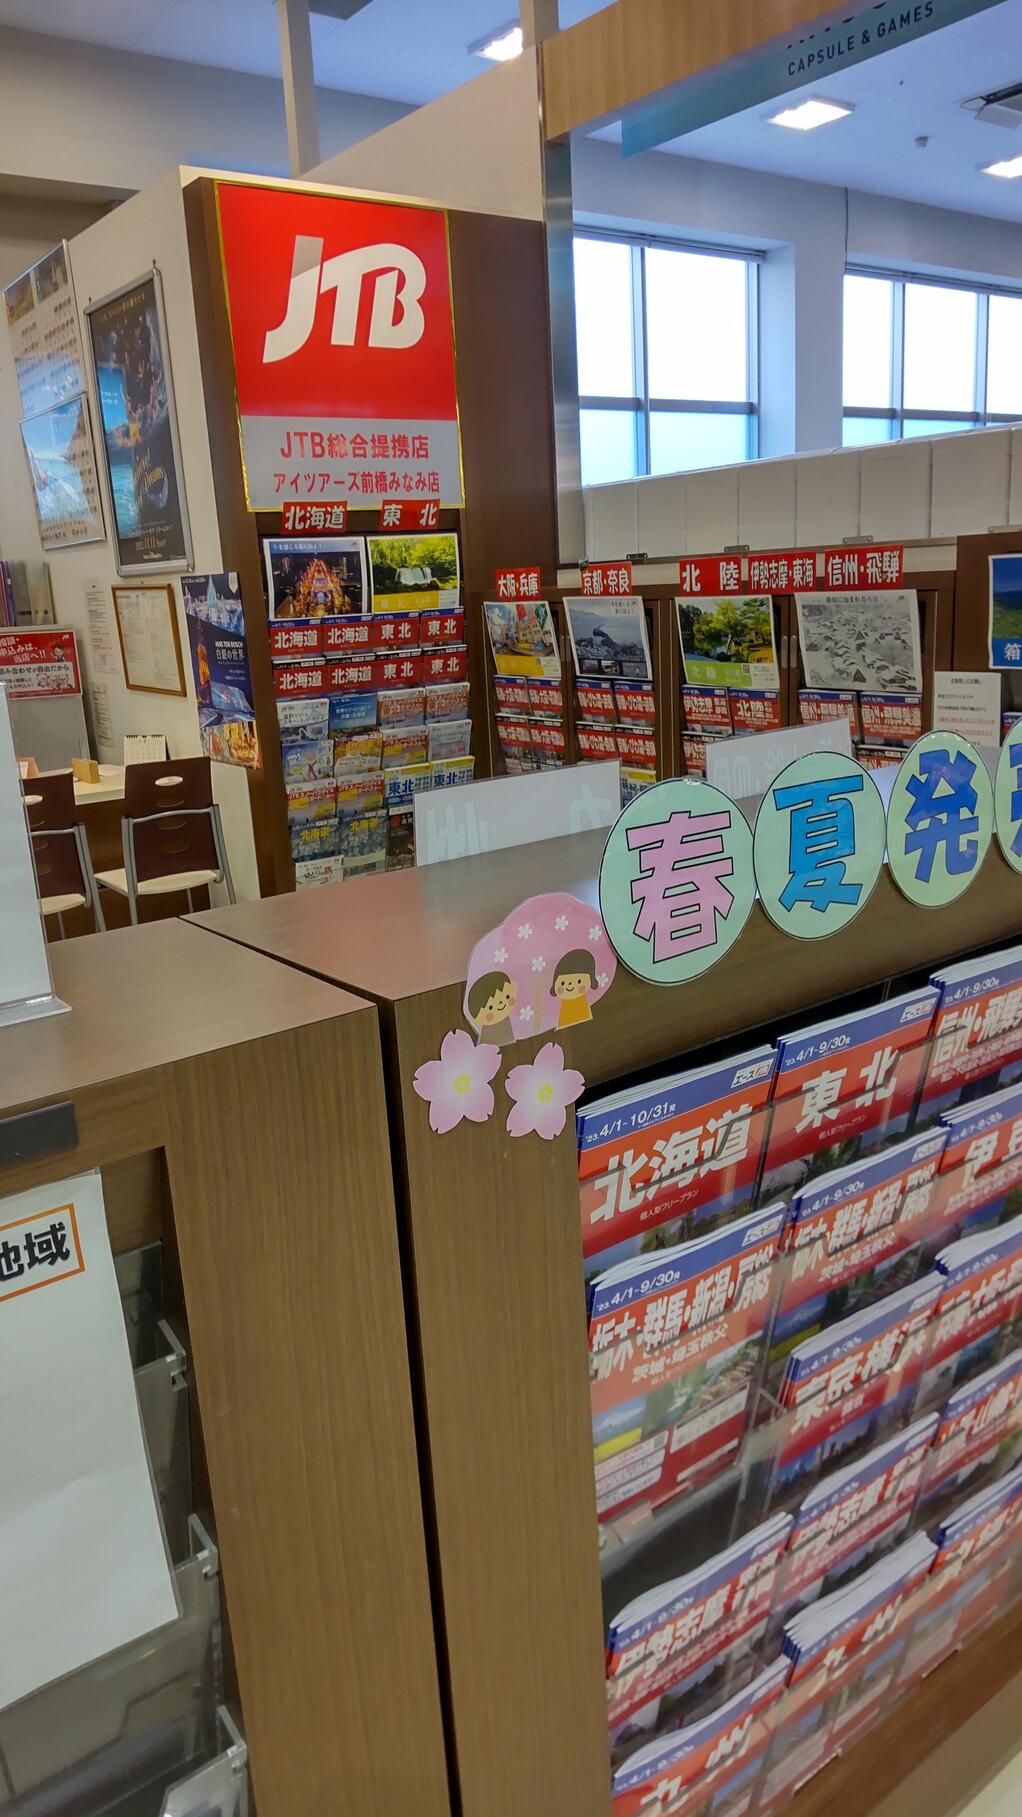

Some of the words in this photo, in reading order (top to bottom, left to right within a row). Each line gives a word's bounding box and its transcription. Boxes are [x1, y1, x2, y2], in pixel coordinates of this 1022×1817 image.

[788, 36, 855, 76] CAPSULE
[861, 30, 871, 45] &
[877, 1, 934, 38] GAMES
[262, 235, 427, 364] JTB
[280, 431, 429, 459] JTB総合提携店
[273, 471, 440, 494] アイツアーズ前橋みなみ店
[284, 505, 346, 531] 北海道
[382, 502, 438, 527] 東北
[682, 560, 740, 593] 北陸
[750, 557, 814, 590] 伊勢志摩・東海
[827, 550, 900, 587] 信州・飛騨
[498, 571, 539, 598] 大阪・兵庫
[583, 567, 630, 596] 京都・奈良
[275, 629, 318, 649] 北海道
[327, 626, 369, 645] 北海道
[381, 622, 412, 640] 東北
[427, 618, 457, 636] 東北
[331, 665, 372, 685] 北海道
[383, 661, 414, 680] 東北
[430, 657, 460, 674] 東北
[279, 670, 323, 690] 北海道
[388, 778, 415, 796] 東北
[433, 772, 458, 786] 東北
[795, 1045, 902, 1135] 東北
[590, 1103, 753, 1225] 北海道
